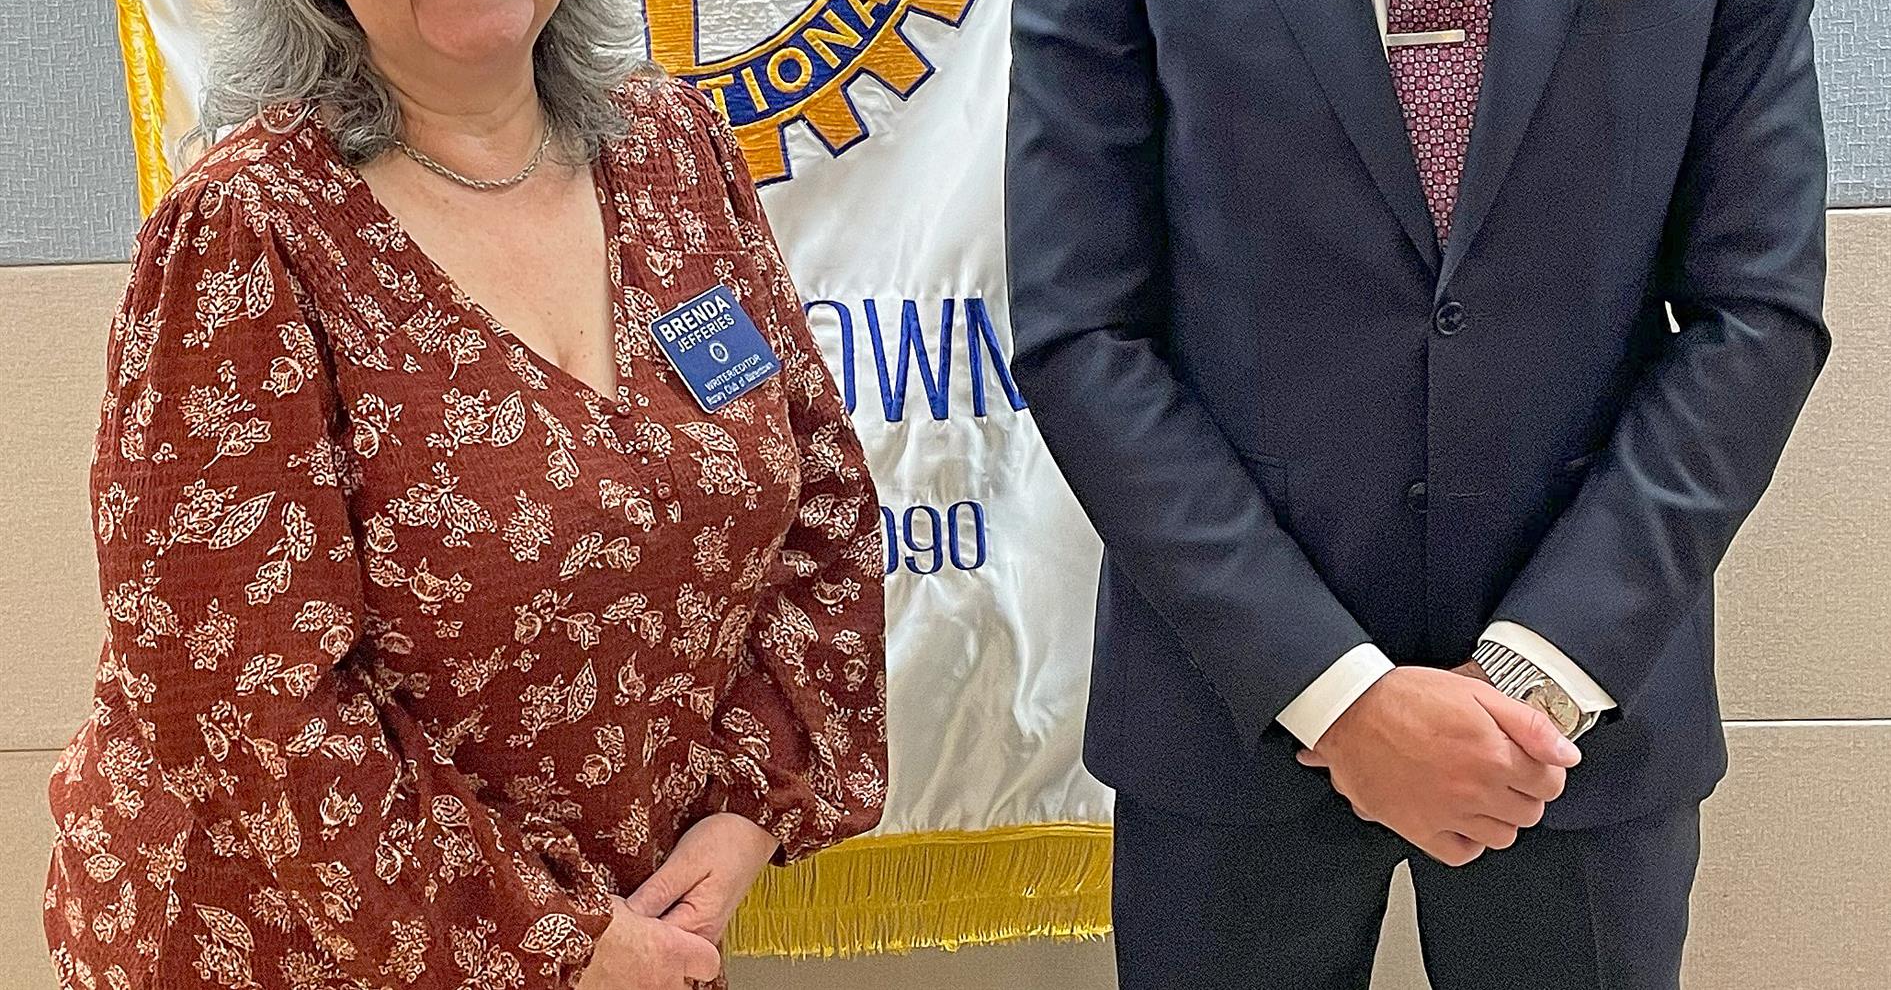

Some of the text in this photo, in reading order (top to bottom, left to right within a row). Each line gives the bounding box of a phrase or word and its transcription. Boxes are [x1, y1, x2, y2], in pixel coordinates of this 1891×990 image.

[659, 295, 731, 343] BRENDA
[678, 314, 735, 353] JEFFERIES
[704, 354, 761, 391] WRITER/EDITOR
[803, 298, 1029, 423] OWN
